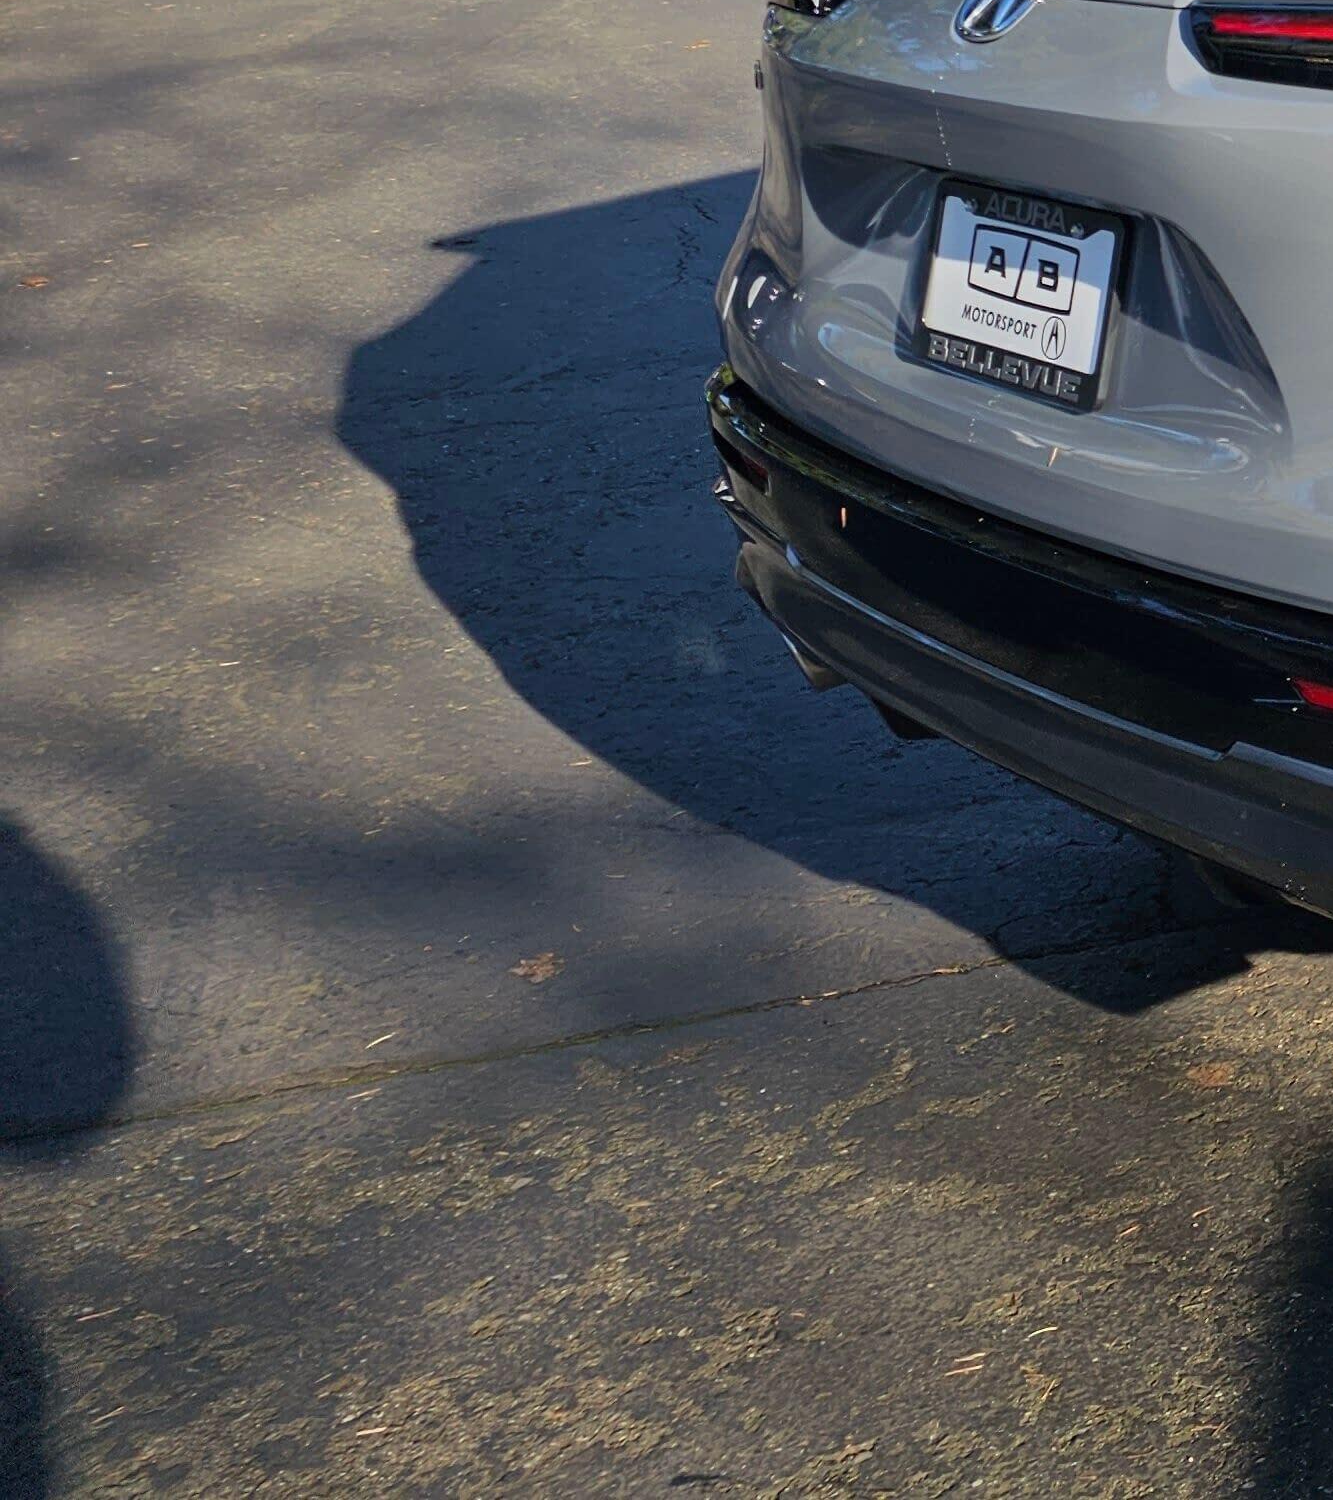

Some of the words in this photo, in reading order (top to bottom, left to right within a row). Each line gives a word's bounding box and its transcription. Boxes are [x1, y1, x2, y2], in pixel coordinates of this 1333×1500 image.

[984, 189, 1066, 234] ACURA
[985, 246, 1006, 279] A
[1037, 259, 1060, 292] B
[961, 303, 1038, 340] MOTORSPORT
[928, 333, 1083, 403] BELLEVUE
